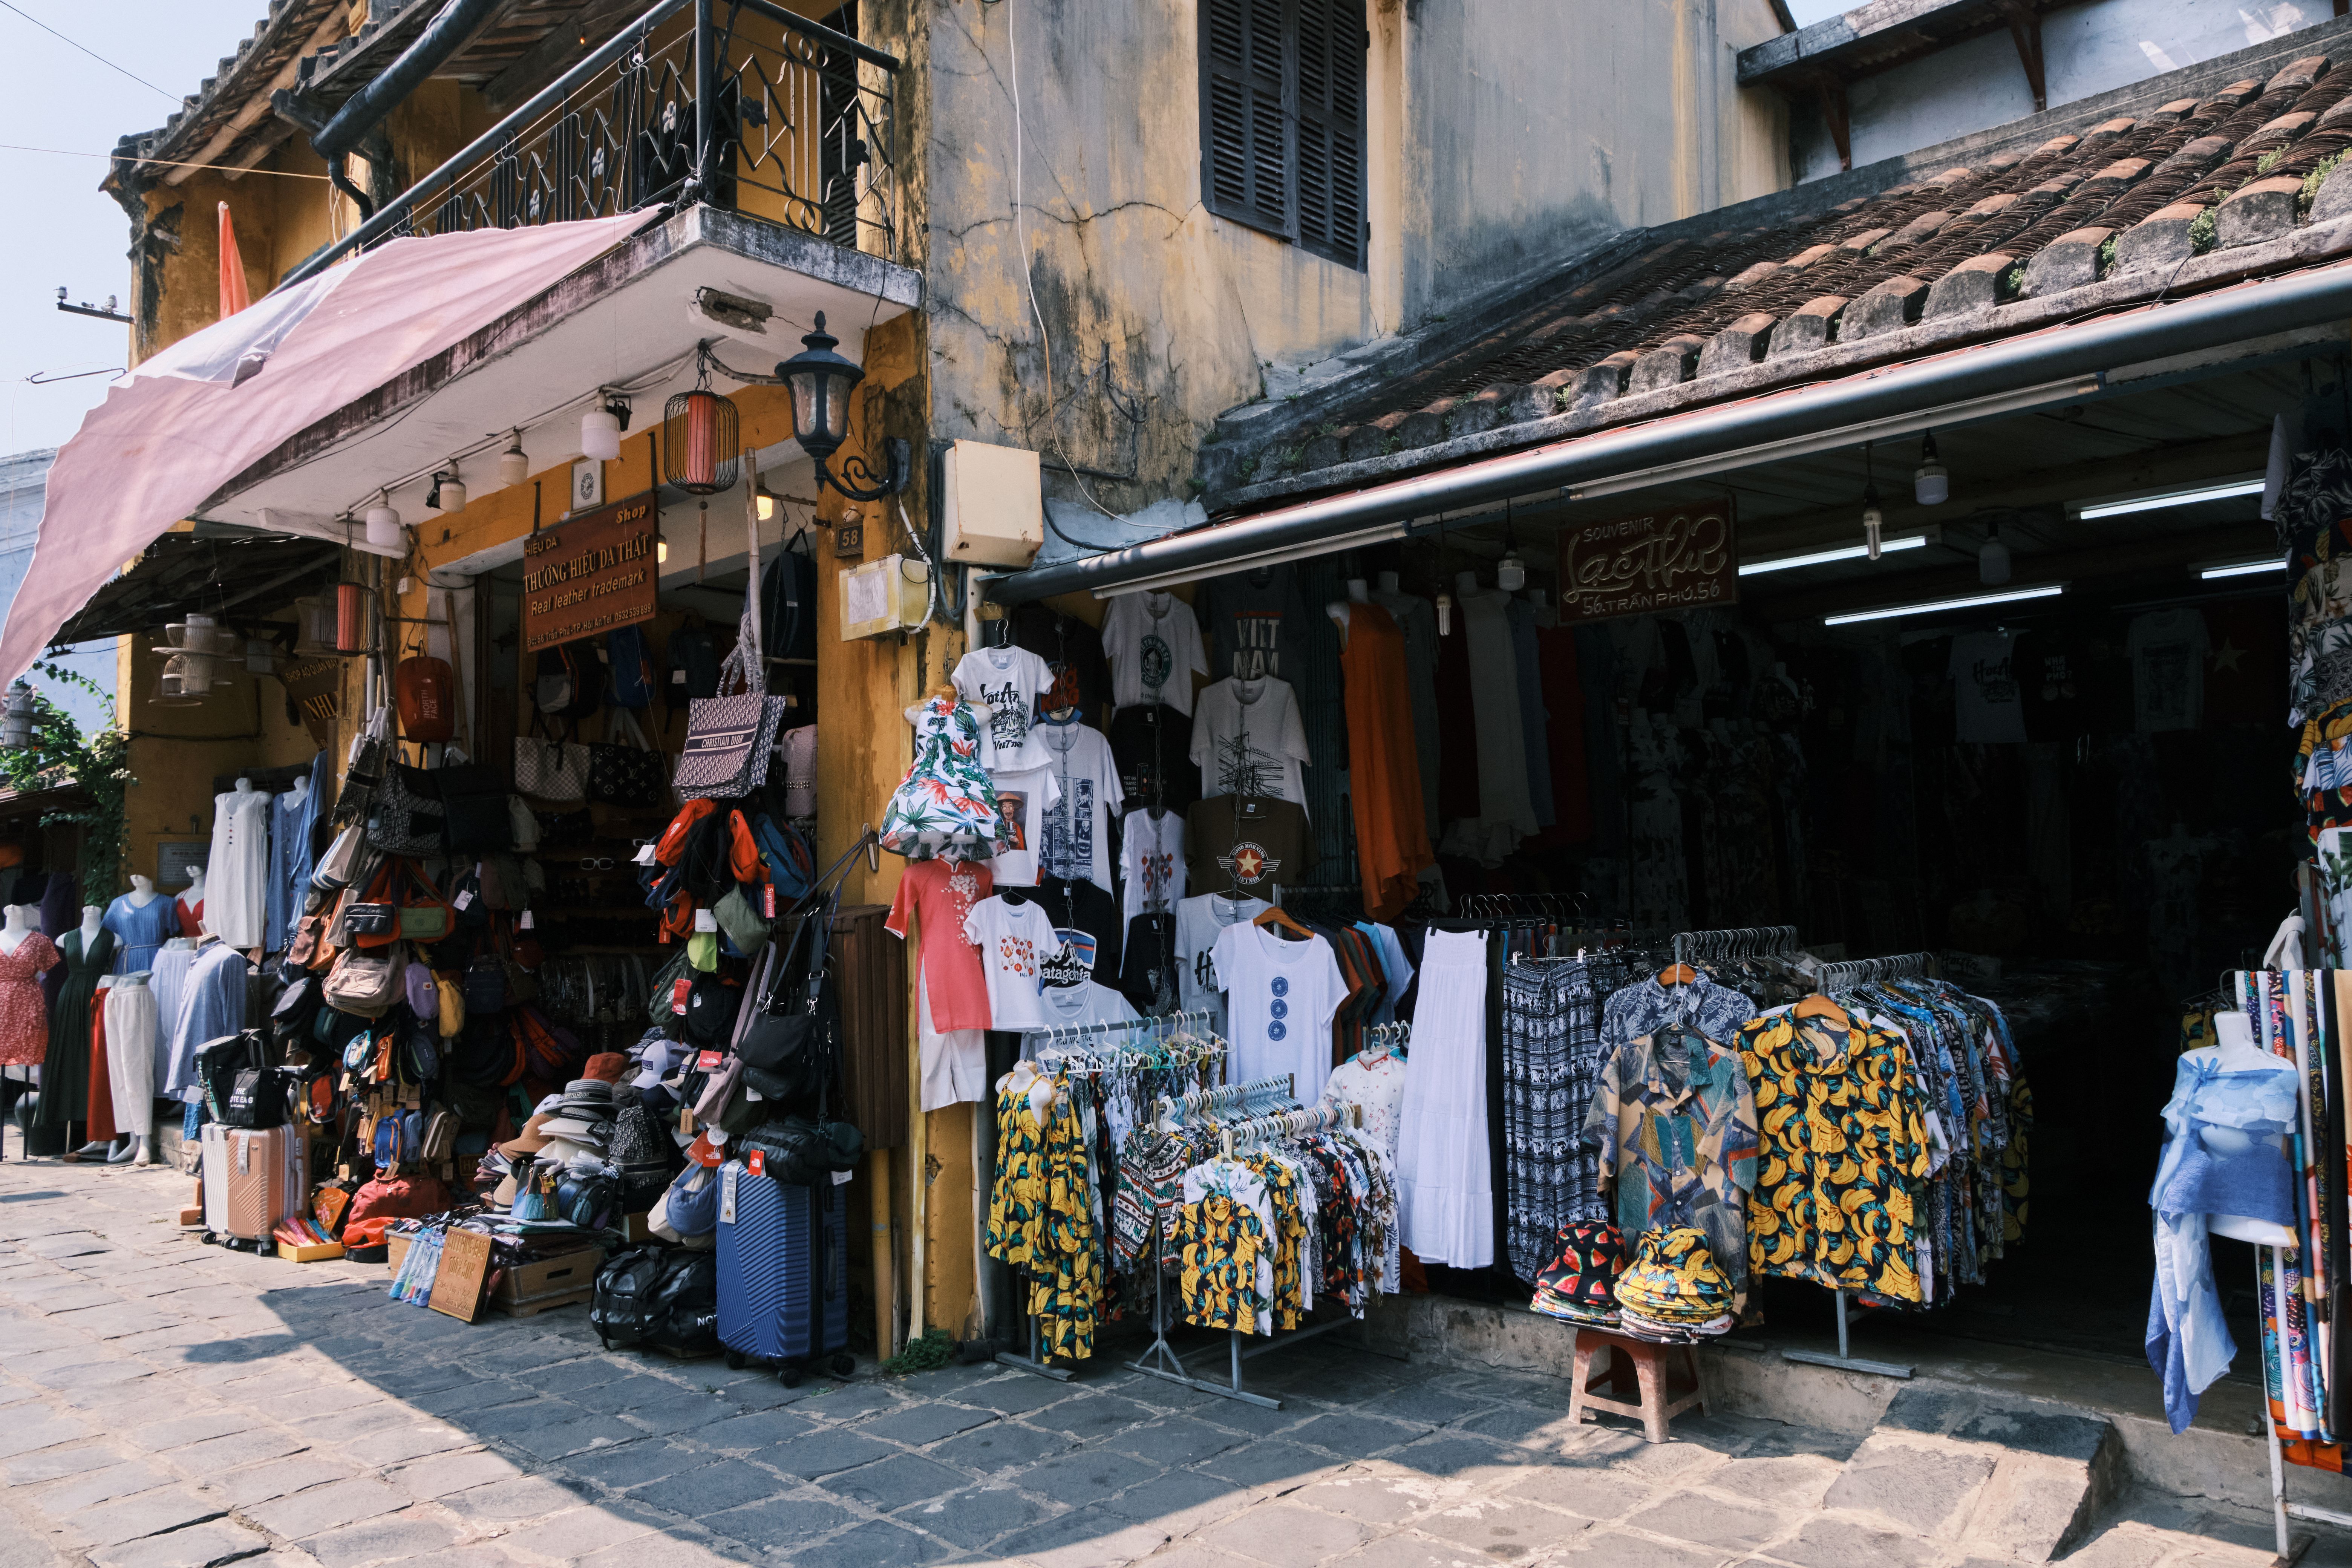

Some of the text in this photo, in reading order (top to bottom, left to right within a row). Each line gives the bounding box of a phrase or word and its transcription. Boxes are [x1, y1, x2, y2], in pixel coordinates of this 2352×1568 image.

[616, 505, 646, 524] Shop
[842, 530, 858, 547] 58
[1583, 517, 1654, 543] SOUVENIR
[525, 536, 557, 557] HIỆU DA
[523, 532, 649, 593] THƯƠNG HIỆU DA THẬT
[531, 568, 644, 616] Real leather trademark
[537, 634, 544, 643] 58
[594, 618, 602, 628] An
[603, 614, 612, 625] Tel
[285, 670, 301, 683] SHOP
[701, 735, 744, 748] CHRISTIAN DIOR
[1250, 746, 1270, 758] vietnam
[1232, 843, 1266, 858] GOOD MORNING
